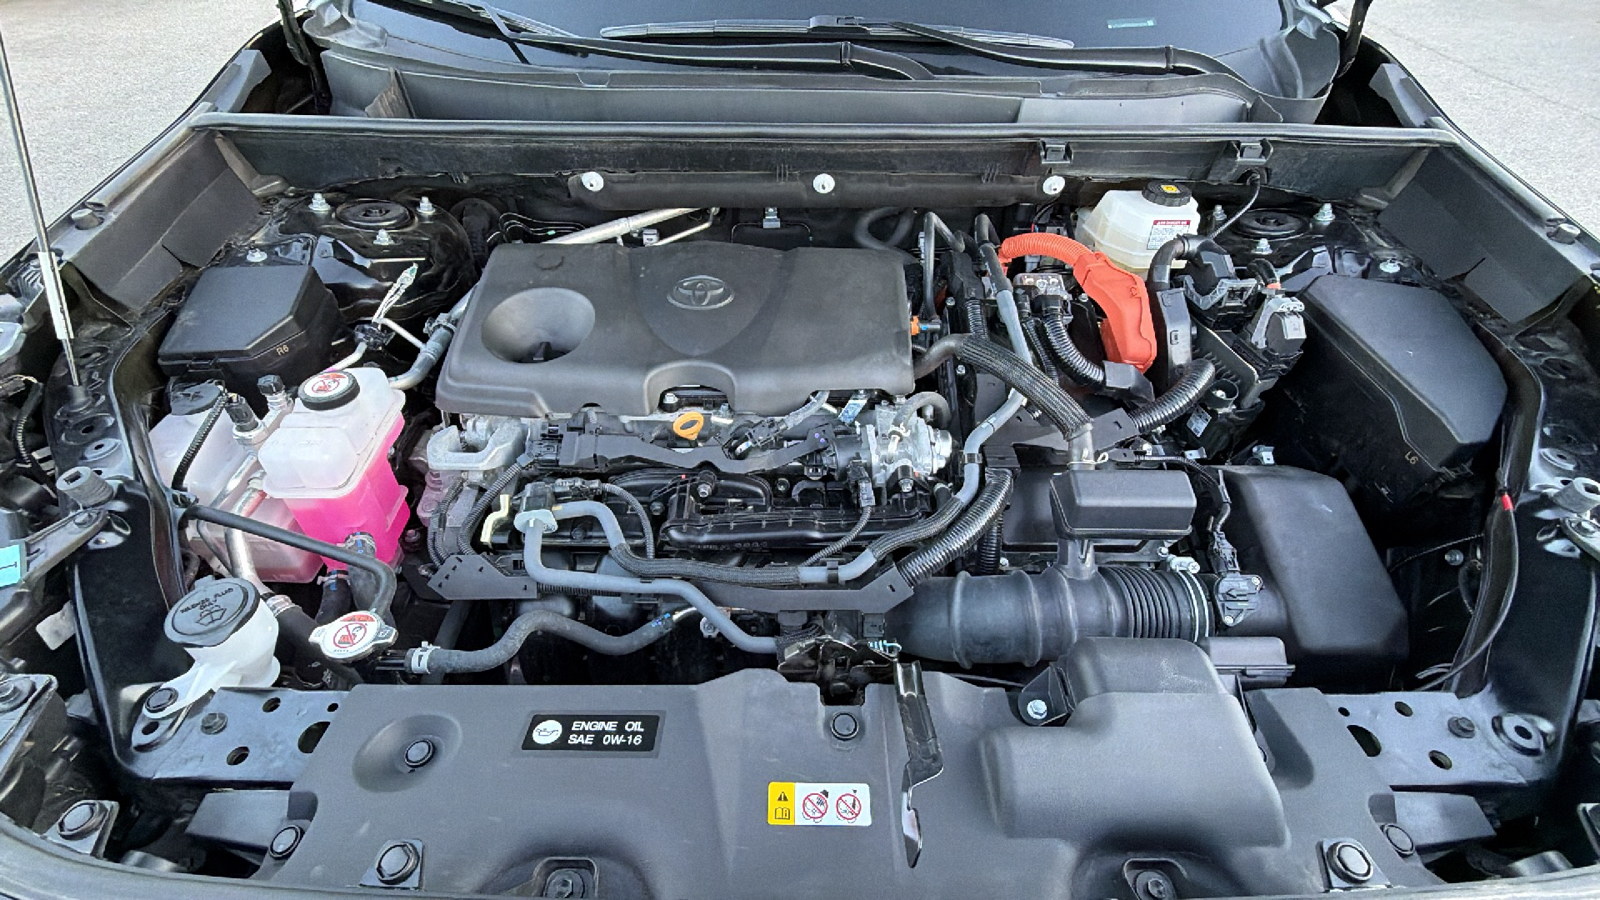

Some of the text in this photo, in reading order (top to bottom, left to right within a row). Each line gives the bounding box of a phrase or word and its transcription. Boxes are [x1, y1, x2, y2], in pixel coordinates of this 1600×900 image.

[276, 344, 290, 356] R6
[1404, 450, 1419, 465] L6
[571, 720, 645, 732] ENGINE OIL
[567, 733, 643, 746] SAE 0W-16
